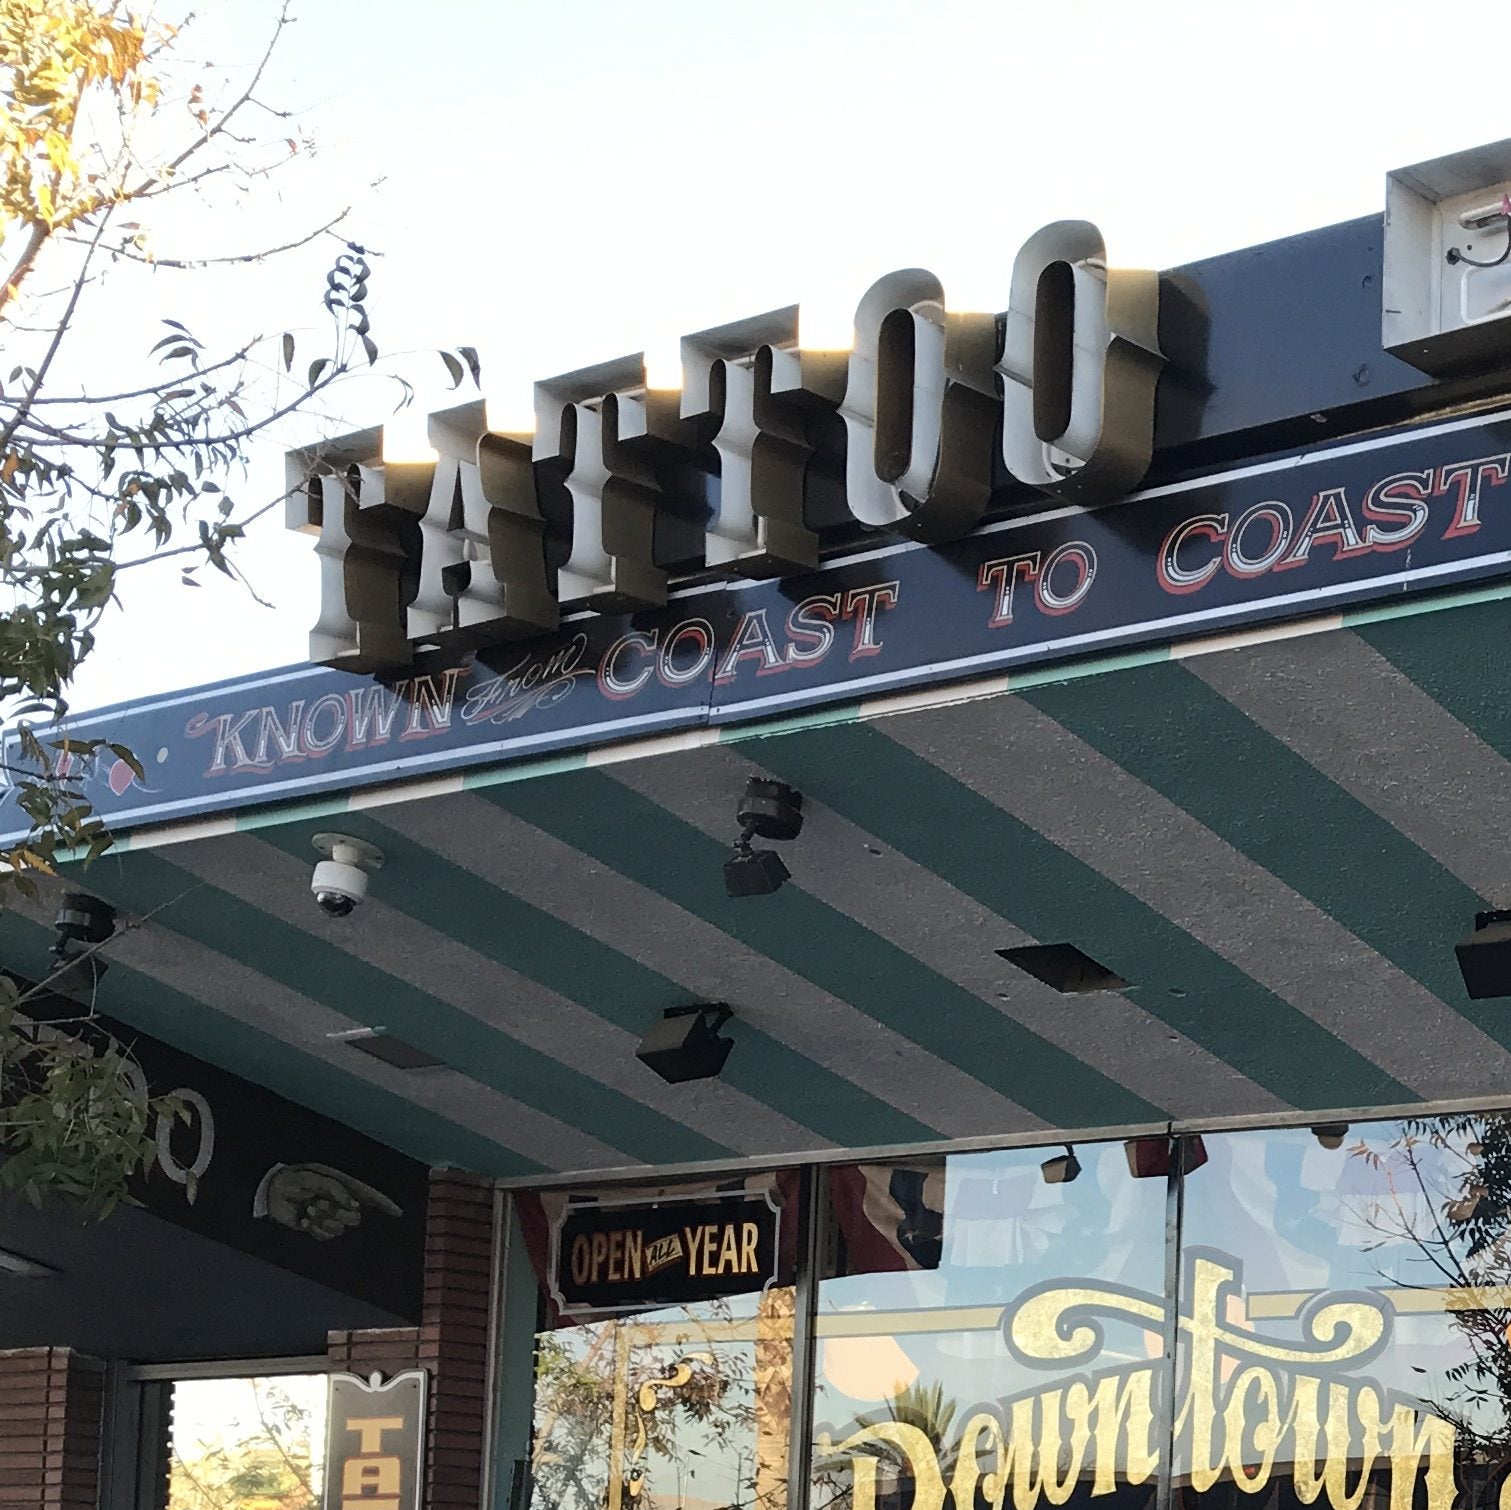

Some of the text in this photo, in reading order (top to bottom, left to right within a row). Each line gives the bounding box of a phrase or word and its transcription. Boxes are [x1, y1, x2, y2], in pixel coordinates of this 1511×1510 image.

[286, 220, 1168, 668] TATTOO
[198, 452, 1511, 777] KNOWN From COAST TO COAST
[570, 1221, 760, 1287] OPEN ALL YEAR
